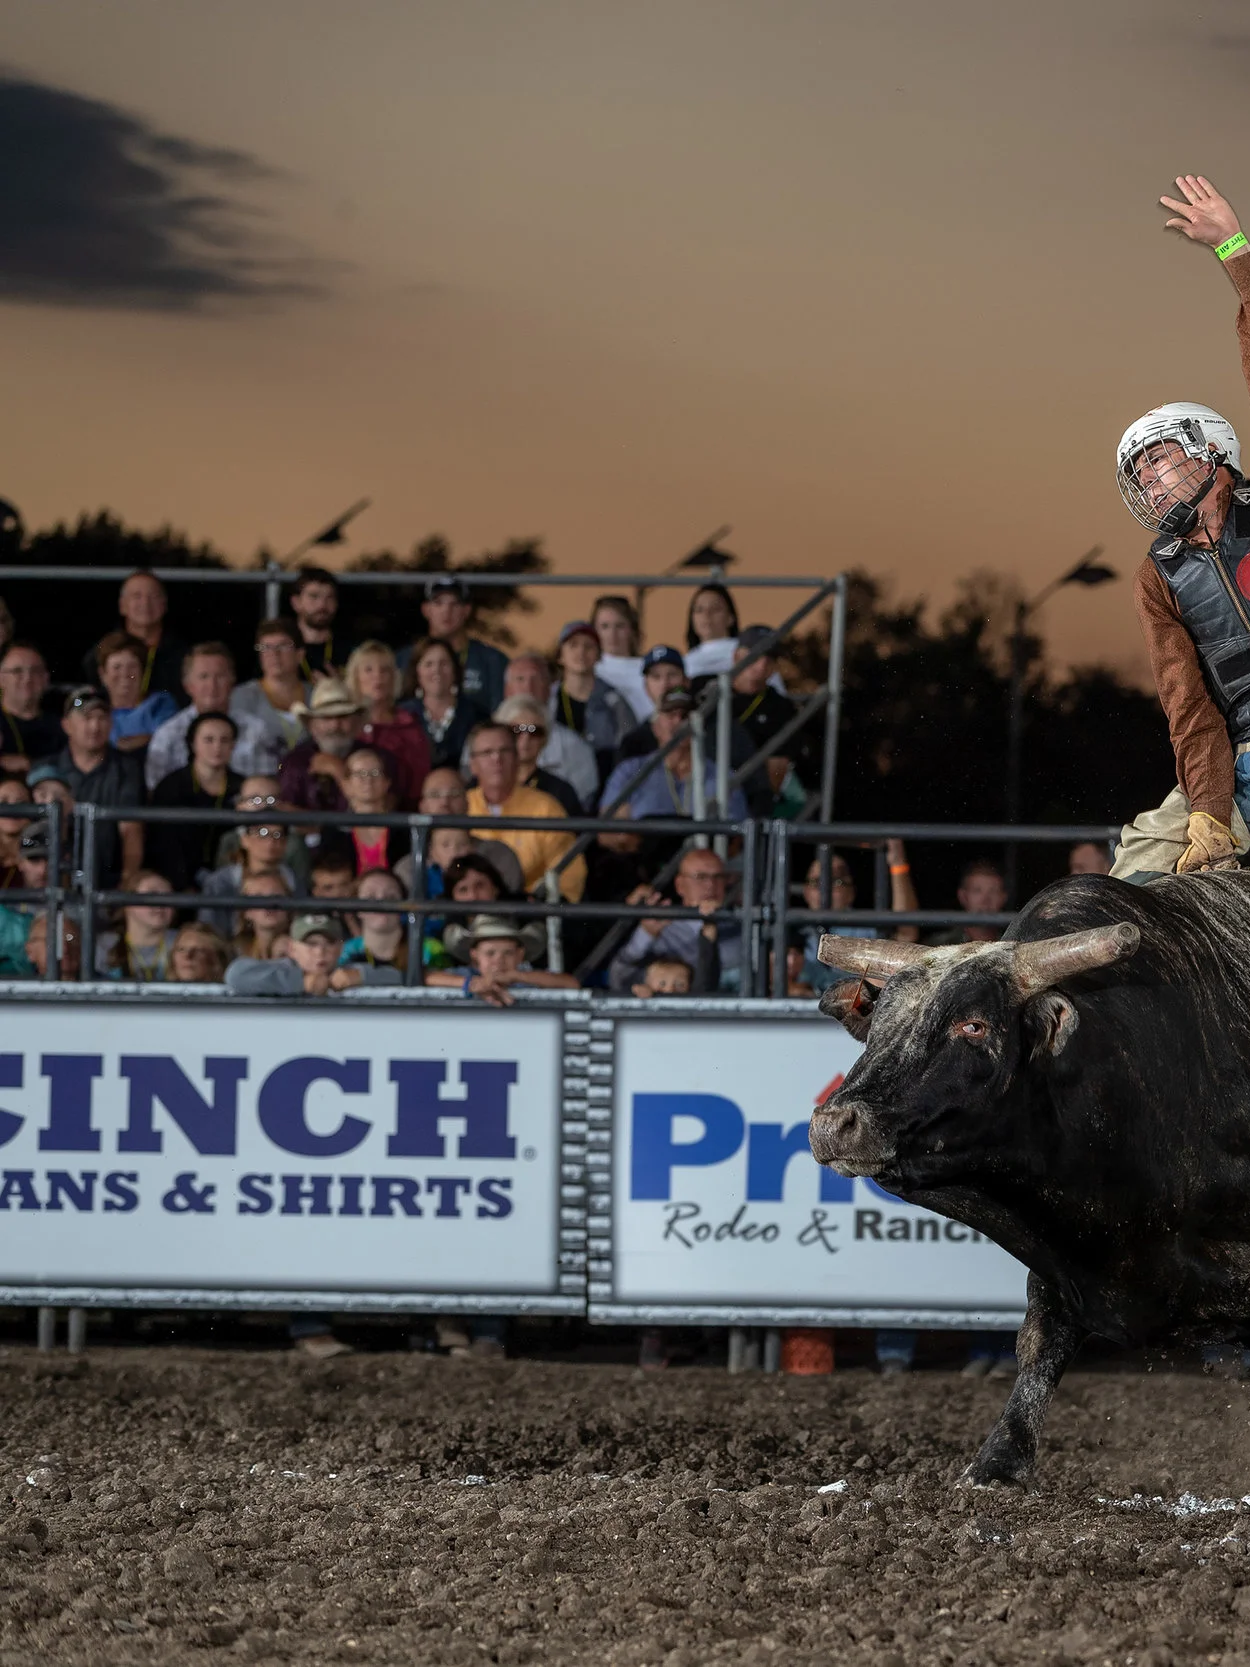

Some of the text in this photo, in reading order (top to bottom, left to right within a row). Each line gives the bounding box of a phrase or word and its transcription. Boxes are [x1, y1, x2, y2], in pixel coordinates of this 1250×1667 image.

[0, 1052, 519, 1159] INCH
[161, 1171, 216, 1214] &
[236, 1174, 514, 1219] SHIRTS
[662, 1201, 995, 1254] Rodeo & Ranc
